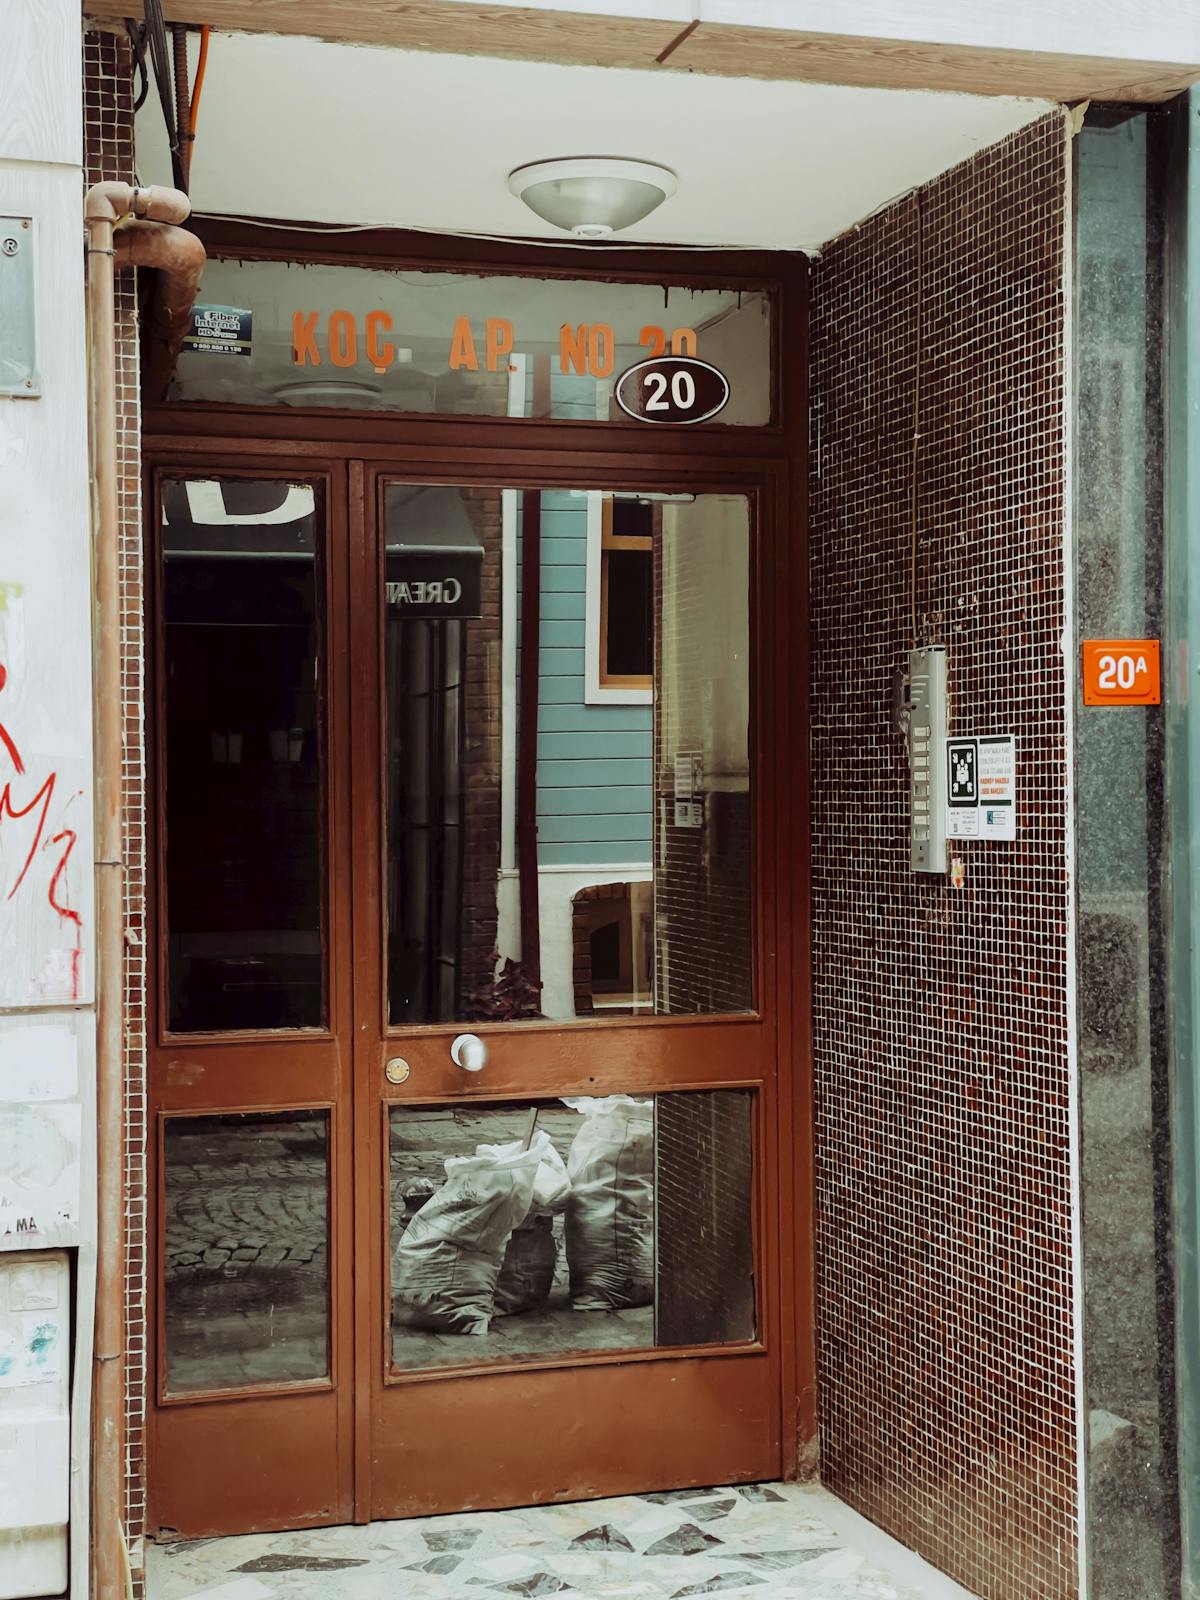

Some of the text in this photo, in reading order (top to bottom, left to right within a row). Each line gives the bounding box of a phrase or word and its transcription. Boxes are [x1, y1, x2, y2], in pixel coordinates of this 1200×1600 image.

[207, 311, 240, 321] Fiber
[292, 310, 395, 374] KOÇ
[560, 322, 615, 378] NO
[643, 370, 696, 412] 20
[1098, 655, 1148, 689] 20A
